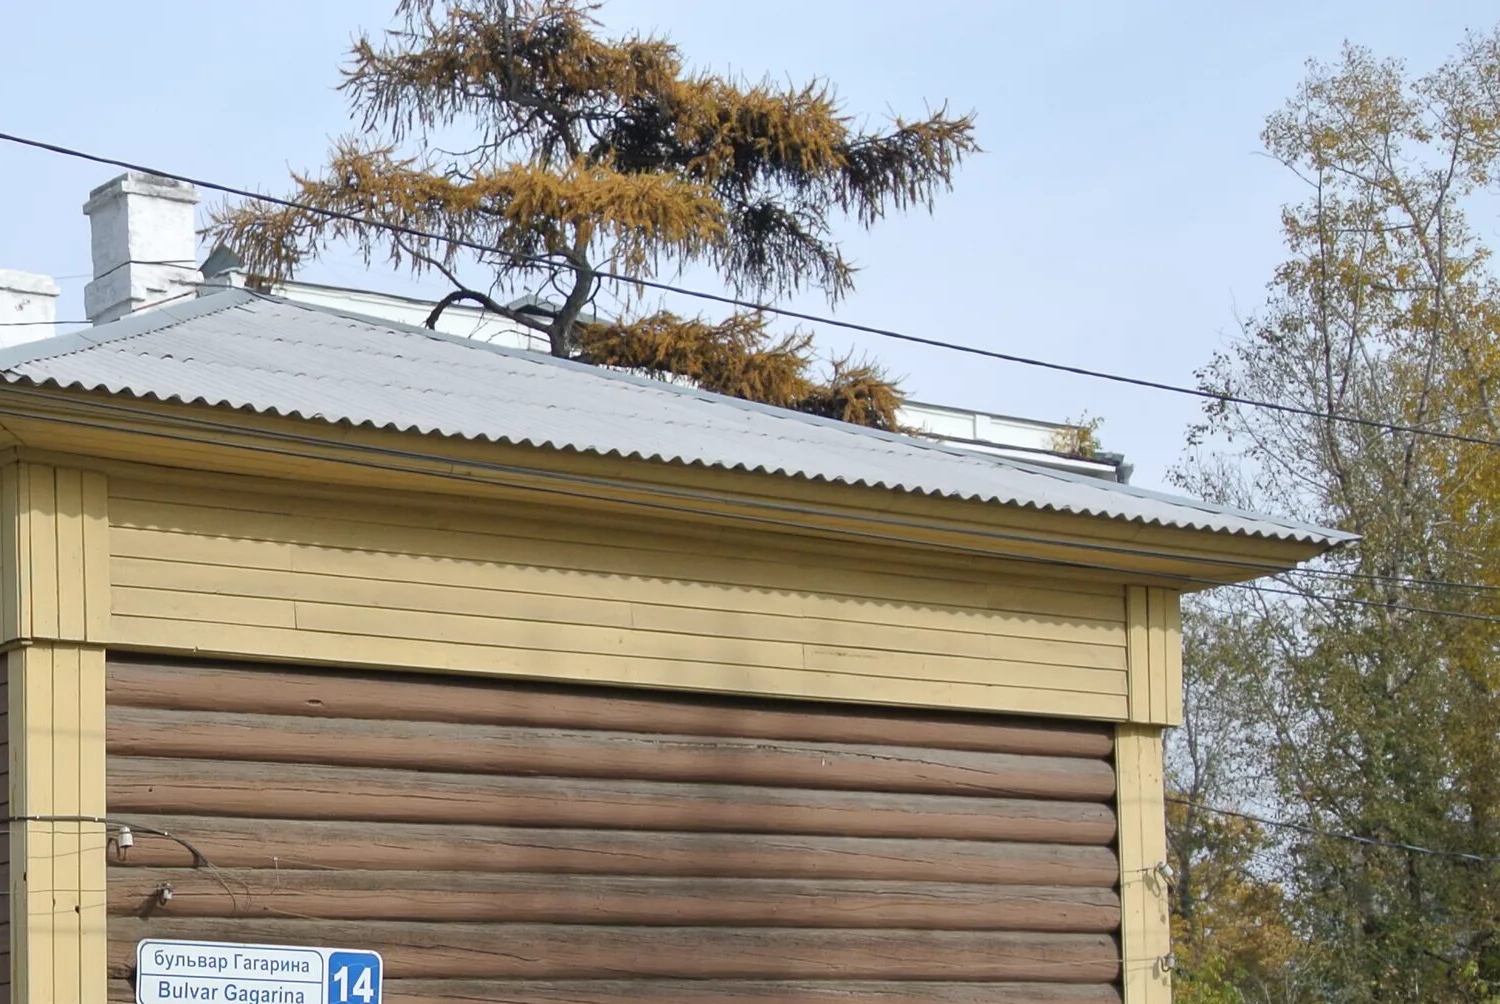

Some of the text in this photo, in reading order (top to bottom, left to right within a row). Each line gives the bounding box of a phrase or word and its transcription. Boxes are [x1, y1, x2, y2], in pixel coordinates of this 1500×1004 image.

[154, 950, 309, 975] бульвар Гагарина
[158, 981, 218, 1001] Bulvar
[333, 965, 374, 1004] 14
